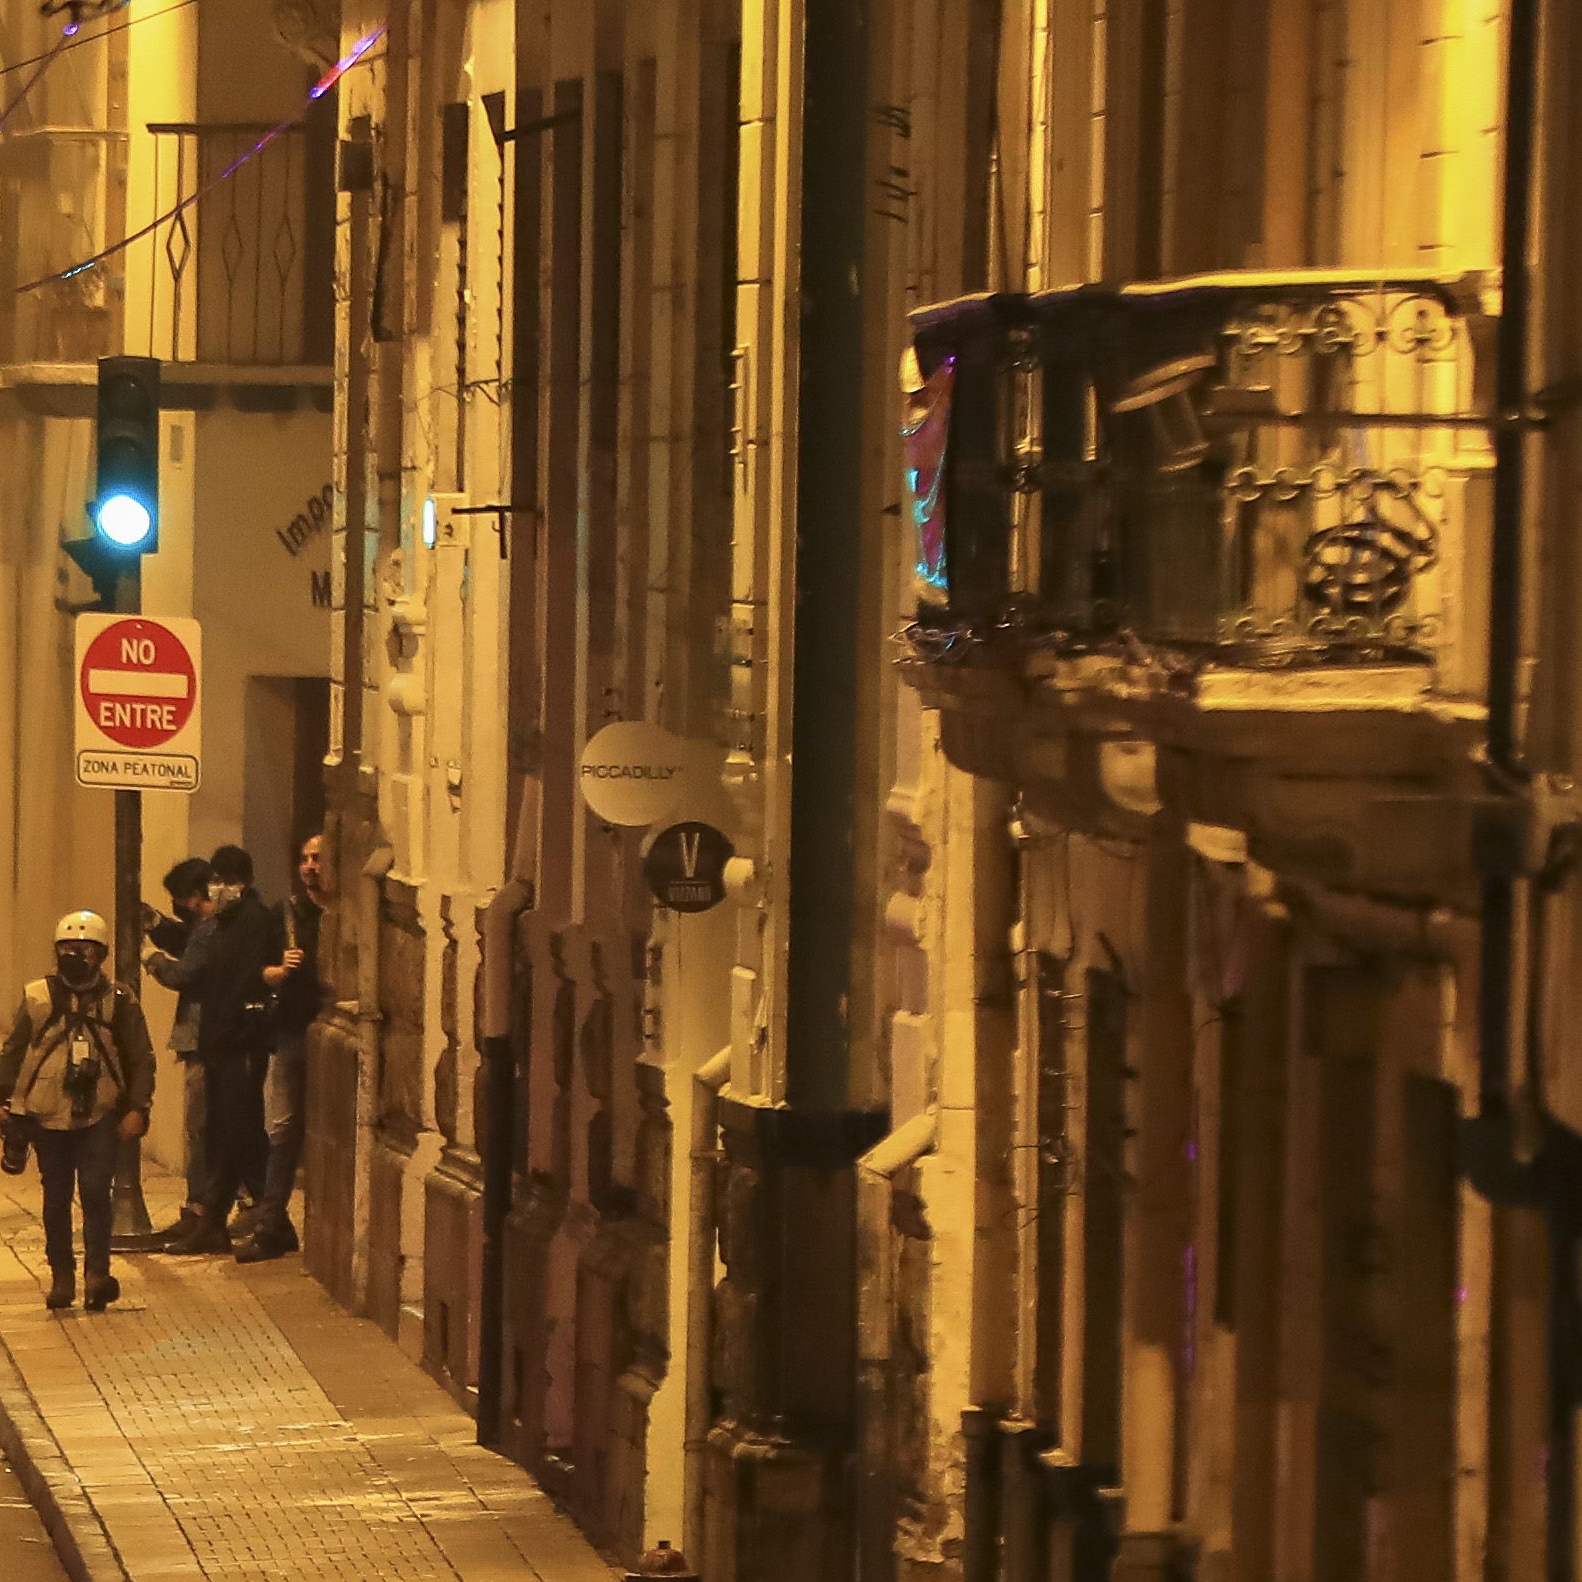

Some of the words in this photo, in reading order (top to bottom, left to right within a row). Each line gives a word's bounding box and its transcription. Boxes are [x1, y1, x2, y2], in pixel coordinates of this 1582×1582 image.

[120, 638, 156, 665] NO
[99, 701, 178, 731] ENTRE
[83, 759, 119, 774] ZONA
[124, 762, 192, 779] PEATONAL
[581, 764, 676, 779] PICCADILLY
